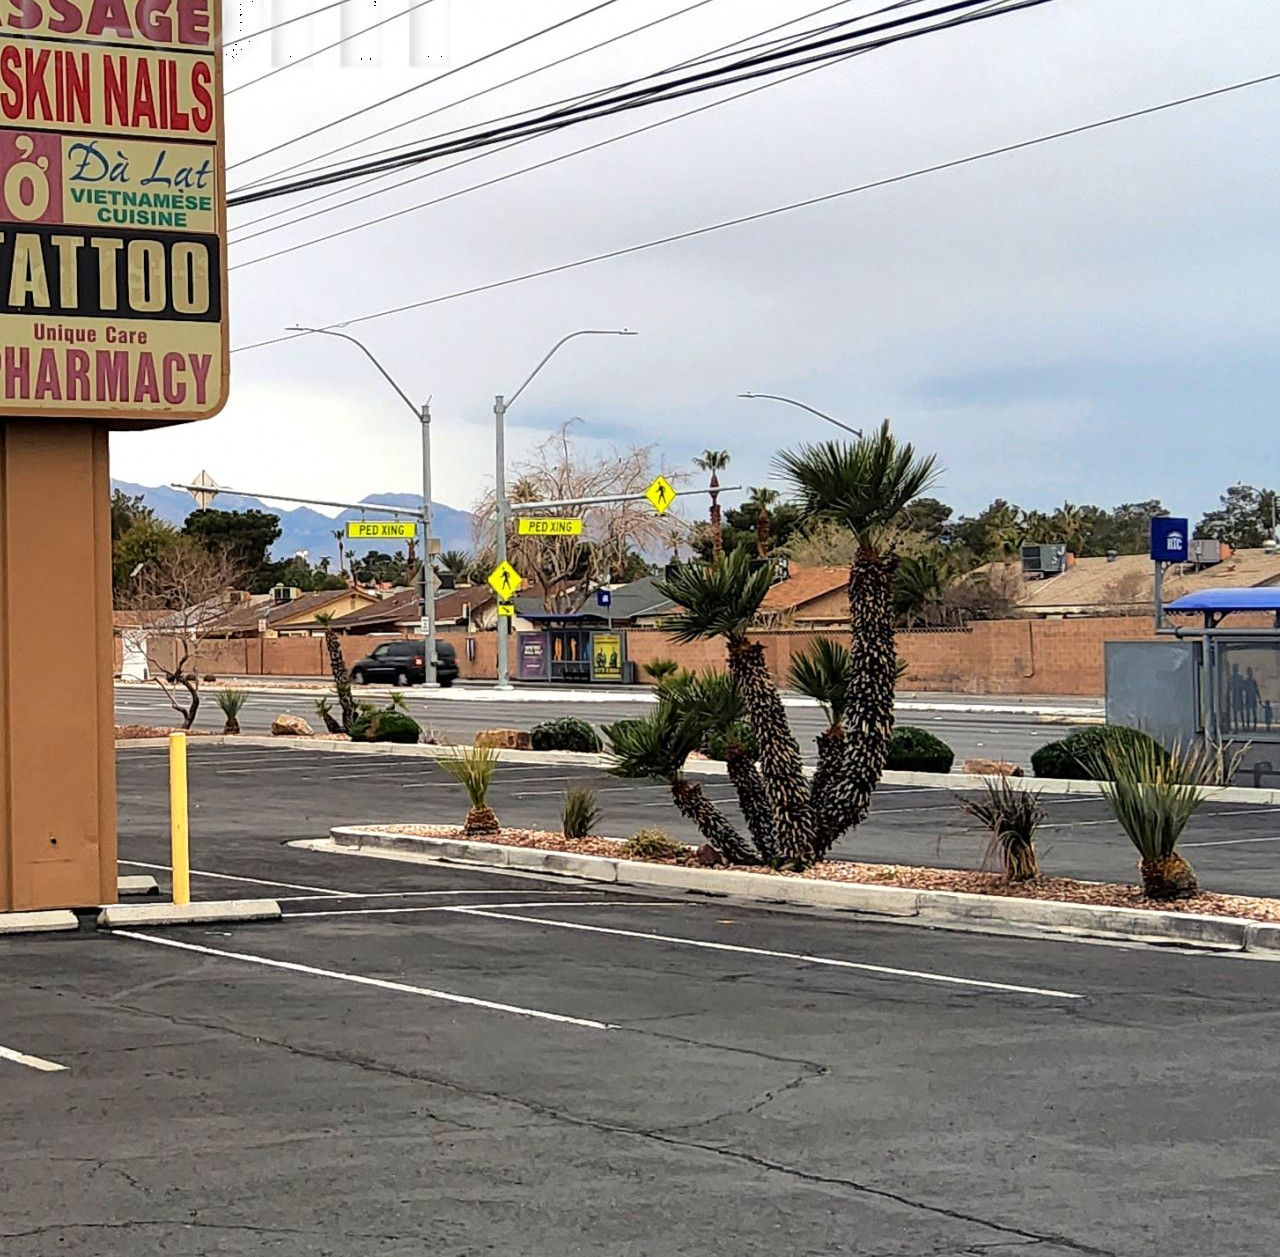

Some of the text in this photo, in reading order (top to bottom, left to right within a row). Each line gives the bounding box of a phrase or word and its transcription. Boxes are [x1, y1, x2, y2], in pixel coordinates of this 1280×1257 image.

[0, 46, 92, 124] SKIN
[104, 54, 213, 133] NAILS
[70, 187, 211, 211] VIETNAMESE
[97, 208, 187, 227] CUISINE
[33, 323, 147, 345] Unique Care
[358, 524, 405, 537] PED XING
[528, 521, 573, 533] PED XING
